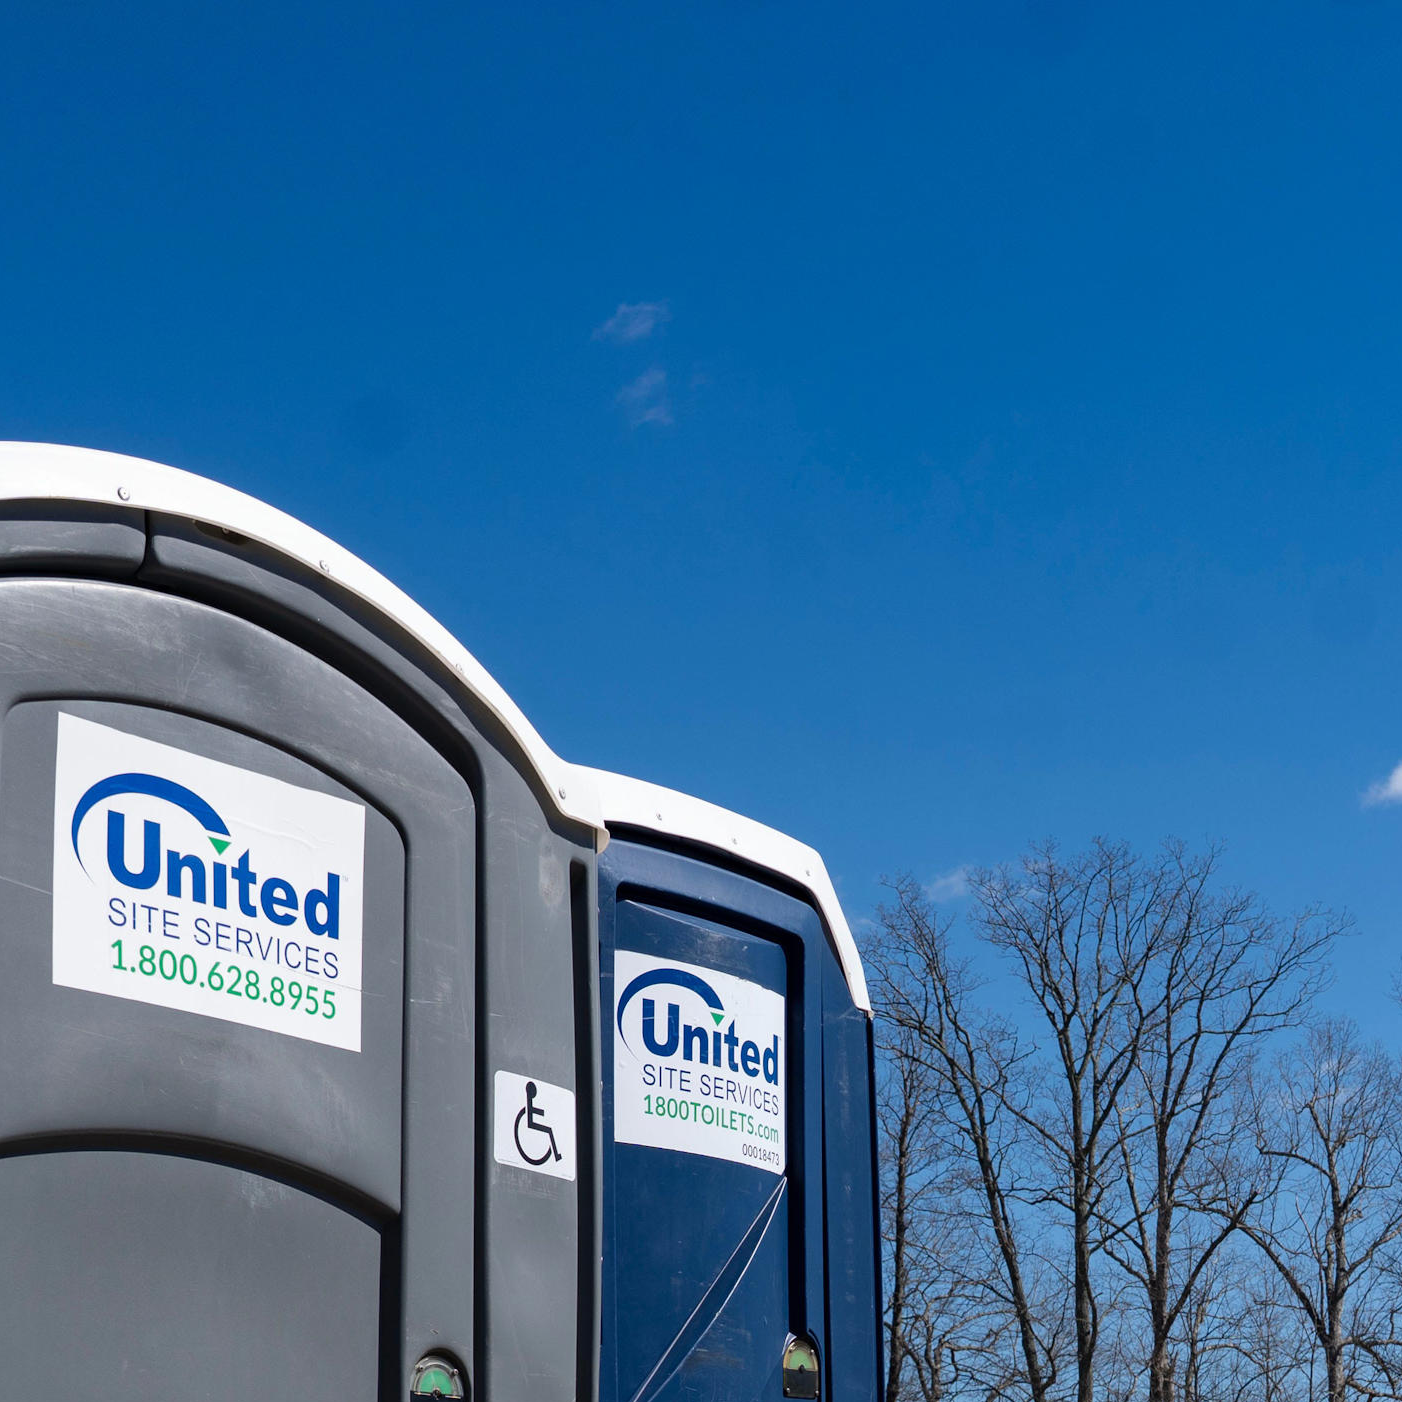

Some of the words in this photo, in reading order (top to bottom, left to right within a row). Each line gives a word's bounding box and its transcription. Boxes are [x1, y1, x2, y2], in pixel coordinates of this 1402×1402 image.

[107, 809, 340, 940] United
[108, 897, 180, 940] SITE
[194, 917, 339, 979] SERVICES
[110, 939, 337, 1020] 1.800.628.8955
[642, 998, 779, 1086] United
[642, 1063, 691, 1093] SITE
[700, 1074, 779, 1116] SERVICES
[644, 1094, 779, 1144] 1800TOILETS.com
[742, 1143, 780, 1166] 00018473
